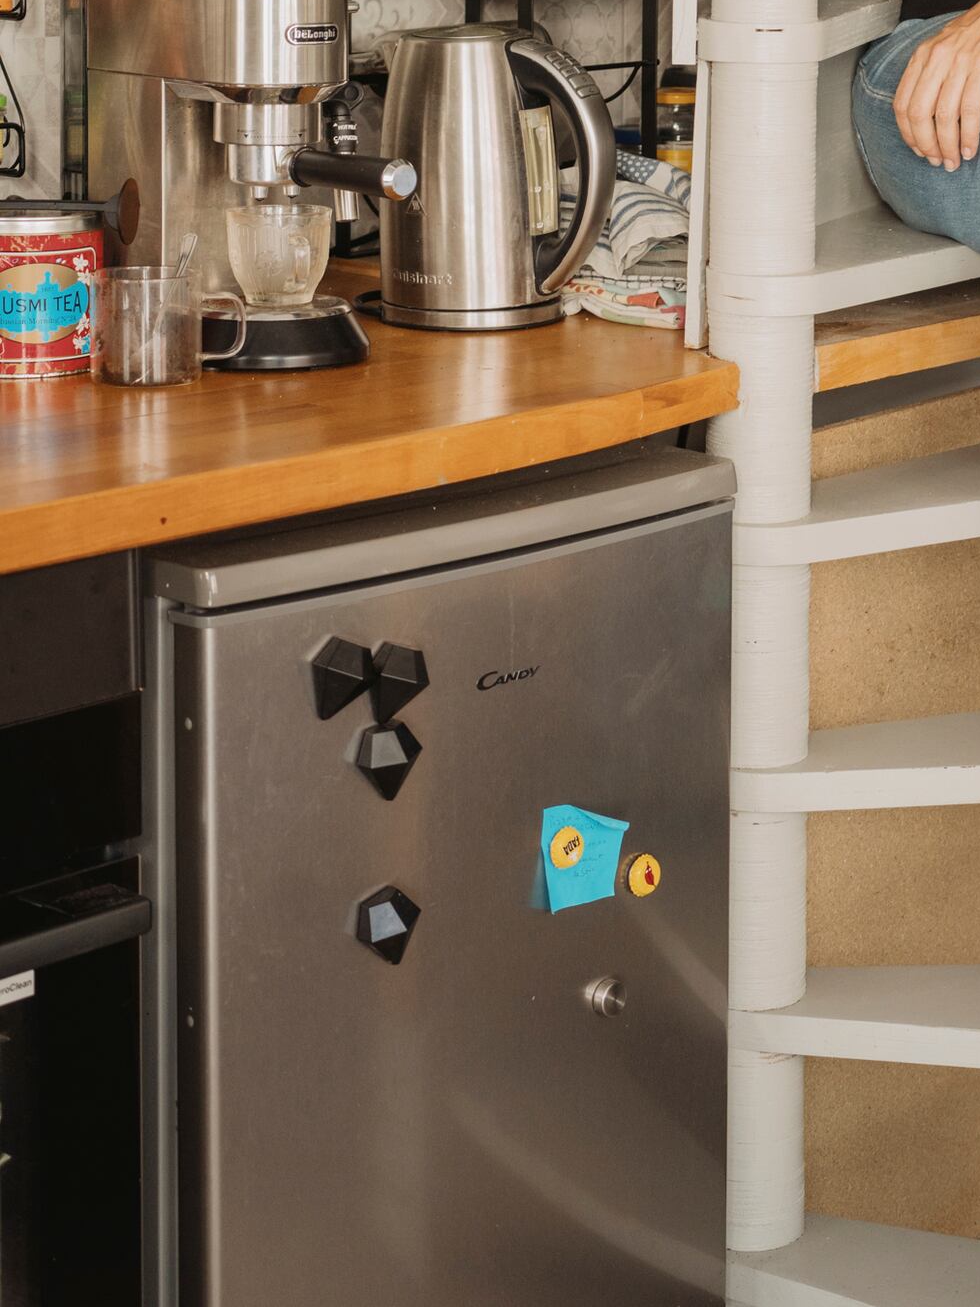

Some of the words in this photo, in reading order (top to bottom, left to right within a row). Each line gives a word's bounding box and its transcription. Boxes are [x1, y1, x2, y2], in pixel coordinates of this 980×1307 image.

[0, 296, 47, 315] USMI
[53, 290, 82, 313] TEA
[563, 835, 581, 856] FADA
